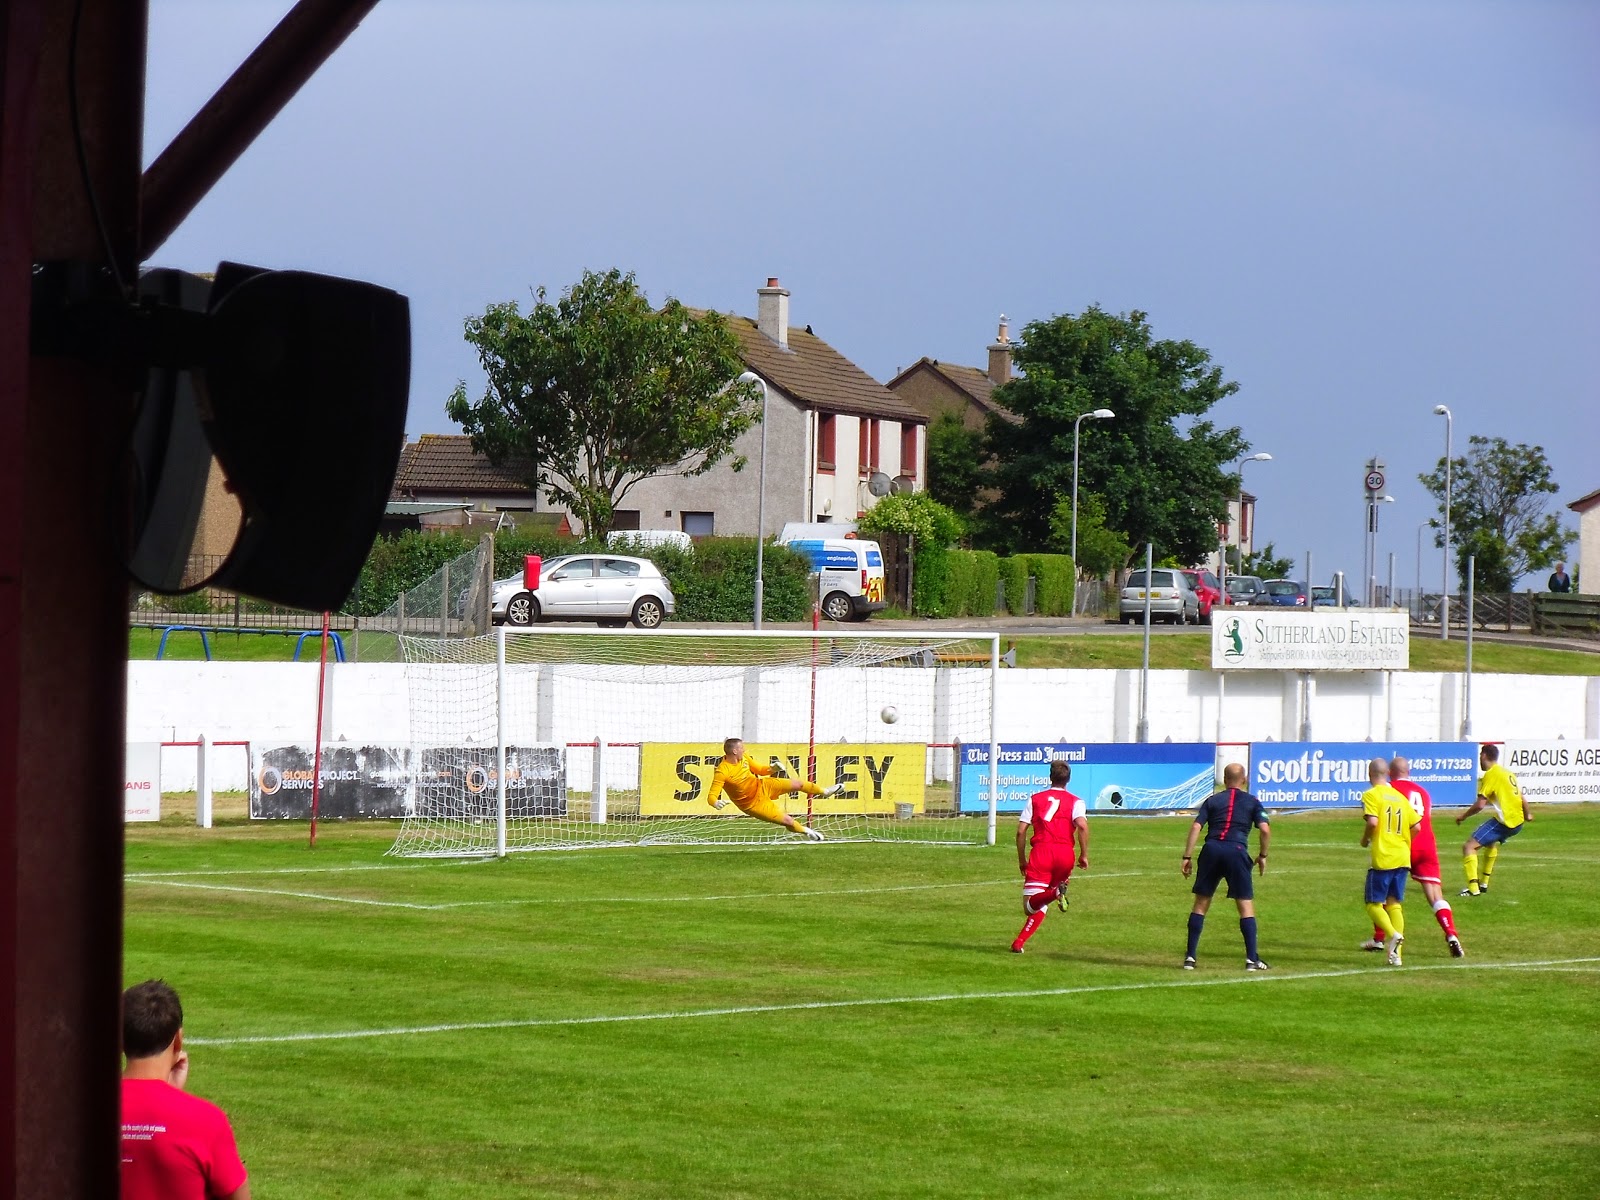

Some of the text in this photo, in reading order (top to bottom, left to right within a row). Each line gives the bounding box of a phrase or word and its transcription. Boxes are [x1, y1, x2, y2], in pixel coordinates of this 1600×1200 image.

[1369, 476, 1382, 485] 30
[1255, 618, 1405, 645] SUTHERLAND ESTATES
[1286, 650, 1310, 661] BRORA
[1311, 650, 1345, 661] RANGERS
[1345, 650, 1379, 662] FOOTBALL
[1380, 651, 1400, 662] CLUB
[967, 745, 1086, 763] The Press and Journal
[1510, 749, 1569, 766] ABACUS
[1258, 749, 1372, 784] scotfram
[1408, 758, 1473, 770] 1463 717328
[282, 770, 358, 780] GLOBA PROJECT
[673, 754, 895, 802] STNLEY
[996, 774, 1030, 788] Highland
[1032, 774, 1053, 788] leagu
[1409, 774, 1472, 782] w.scotframe.co.uk
[124, 782, 151, 790] ANS
[282, 780, 324, 790] SERVICS
[488, 780, 526, 789] SEVICES
[1509, 775, 1519, 796] 9
[1521, 786, 1550, 795] Dundee
[1553, 785, 1576, 795] 01382
[978, 789, 1009, 802] nody
[1010, 789, 1028, 800] does
[1257, 788, 1363, 802] timber frame ho
[1044, 796, 1061, 822] 7
[1409, 790, 1424, 816] 4
[1386, 806, 1402, 835] 11
